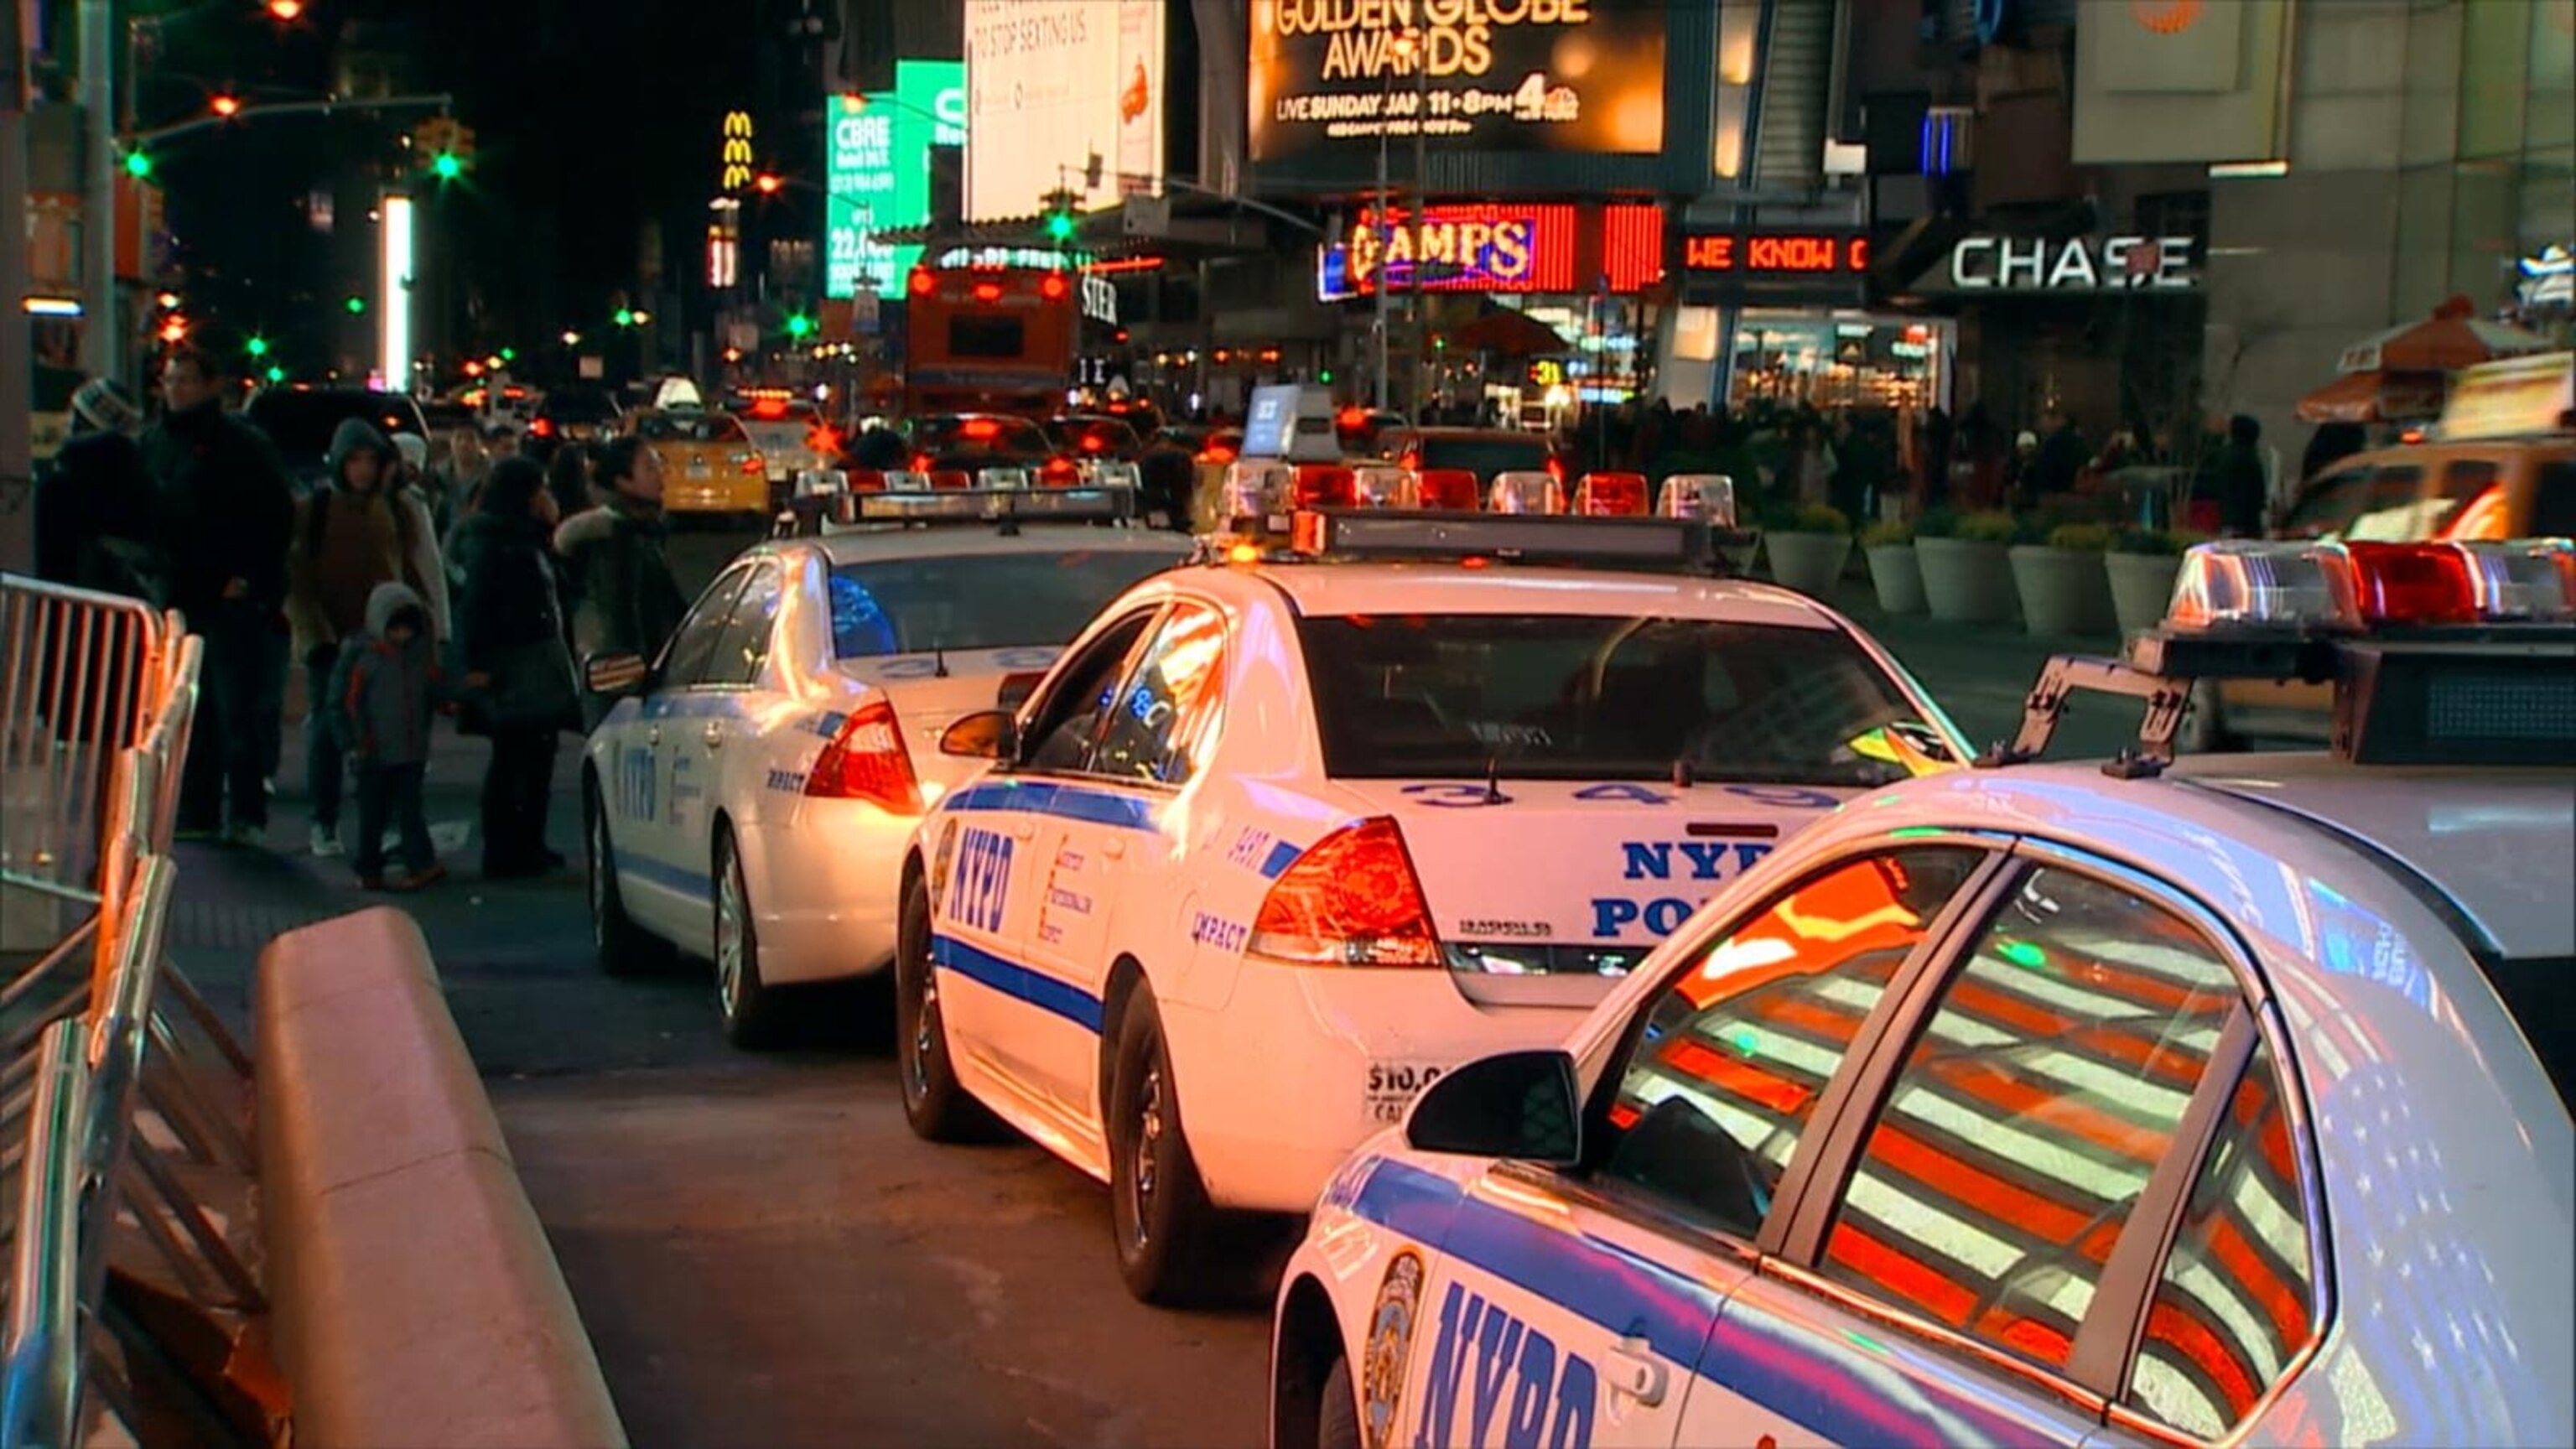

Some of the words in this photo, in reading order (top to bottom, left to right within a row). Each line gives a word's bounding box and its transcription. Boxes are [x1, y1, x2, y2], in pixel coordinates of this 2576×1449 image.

[1277, 0, 1413, 35] GOLDEN
[1425, 0, 1590, 26] GLOBE
[1322, 26, 1492, 80] AWARDS
[1276, 96, 1309, 121] LIVE
[1310, 92, 1382, 120] SUNDAY
[835, 115, 891, 149] CBRE
[1687, 237, 1734, 269] WE
[1749, 238, 1836, 270] KNOW
[1952, 236, 2196, 288] CHASE
[949, 826, 1015, 934] NYPD
[1623, 842, 1774, 880] NYP
[1192, 909, 1247, 955] IMPACT
[1592, 899, 1712, 937] PO
[1415, 1280, 1597, 1449] NYPD
